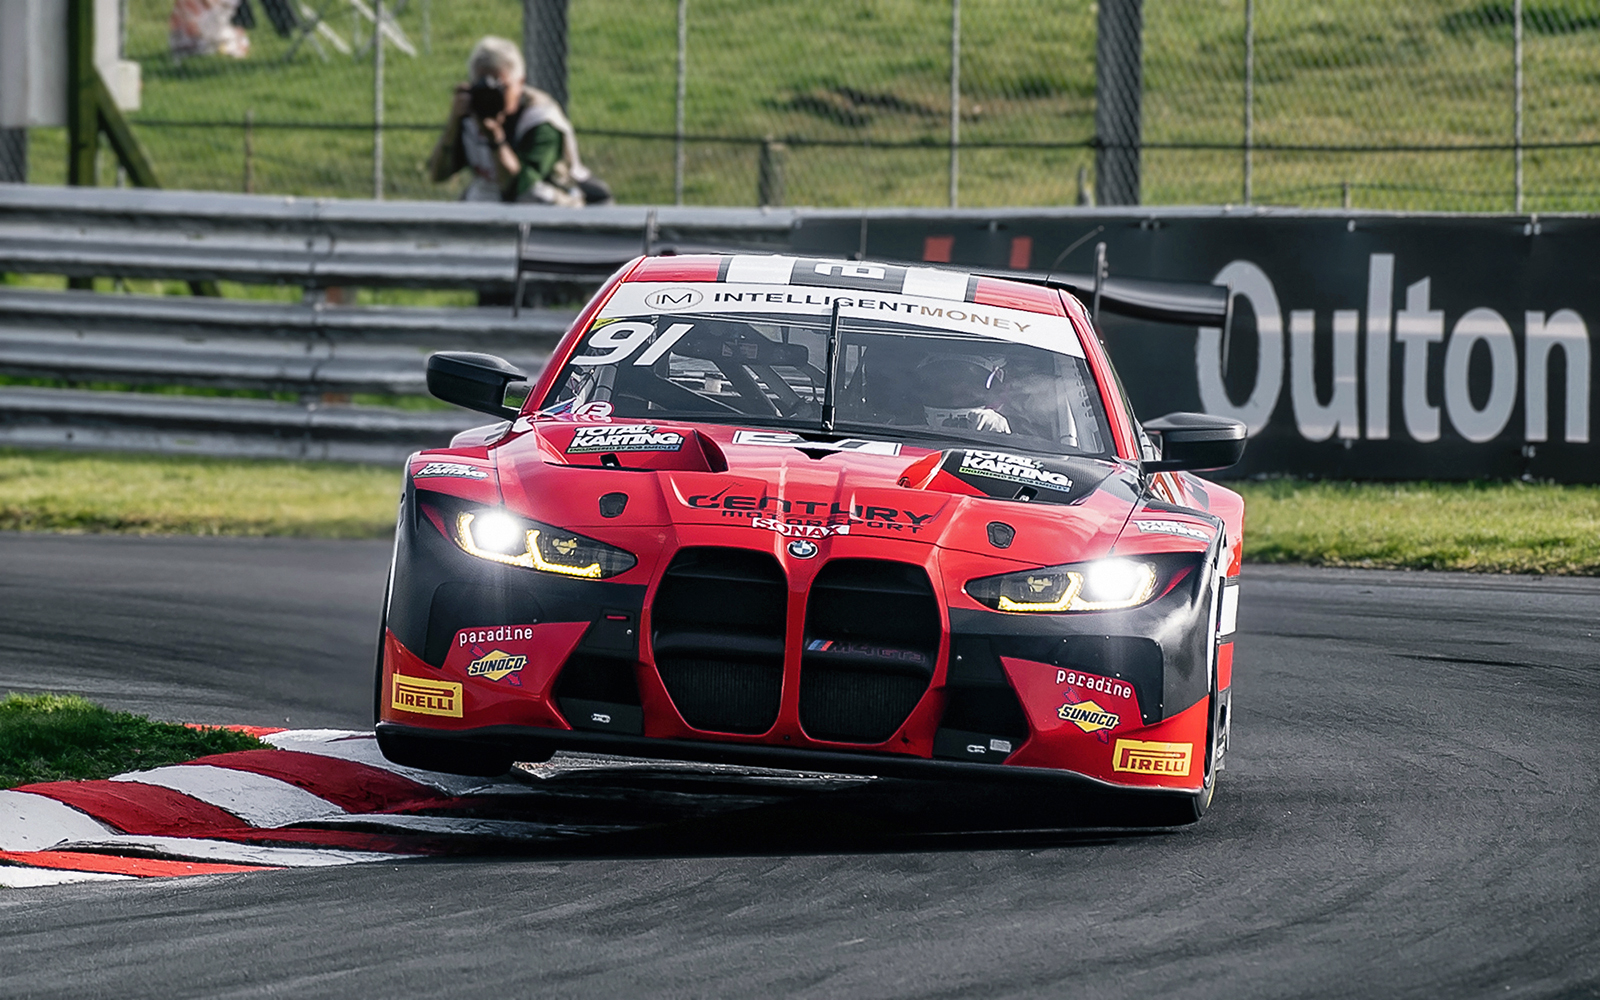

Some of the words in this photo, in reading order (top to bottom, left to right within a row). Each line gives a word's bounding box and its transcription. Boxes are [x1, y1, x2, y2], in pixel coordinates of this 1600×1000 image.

[569, 321, 695, 366] 91
[1195, 253, 1591, 443] Oulton
[576, 425, 648, 437] TOTAL
[963, 449, 1036, 468] TOTAL
[688, 493, 933, 525] CENTURY
[756, 518, 841, 537] SONAX
[459, 626, 533, 647] paradine
[469, 656, 524, 674] SUNOCO
[1056, 669, 1132, 699] paradine
[395, 682, 457, 711] PIRELLI
[1061, 705, 1117, 727] SUNOCO
[1118, 747, 1186, 772] PIRELLI
